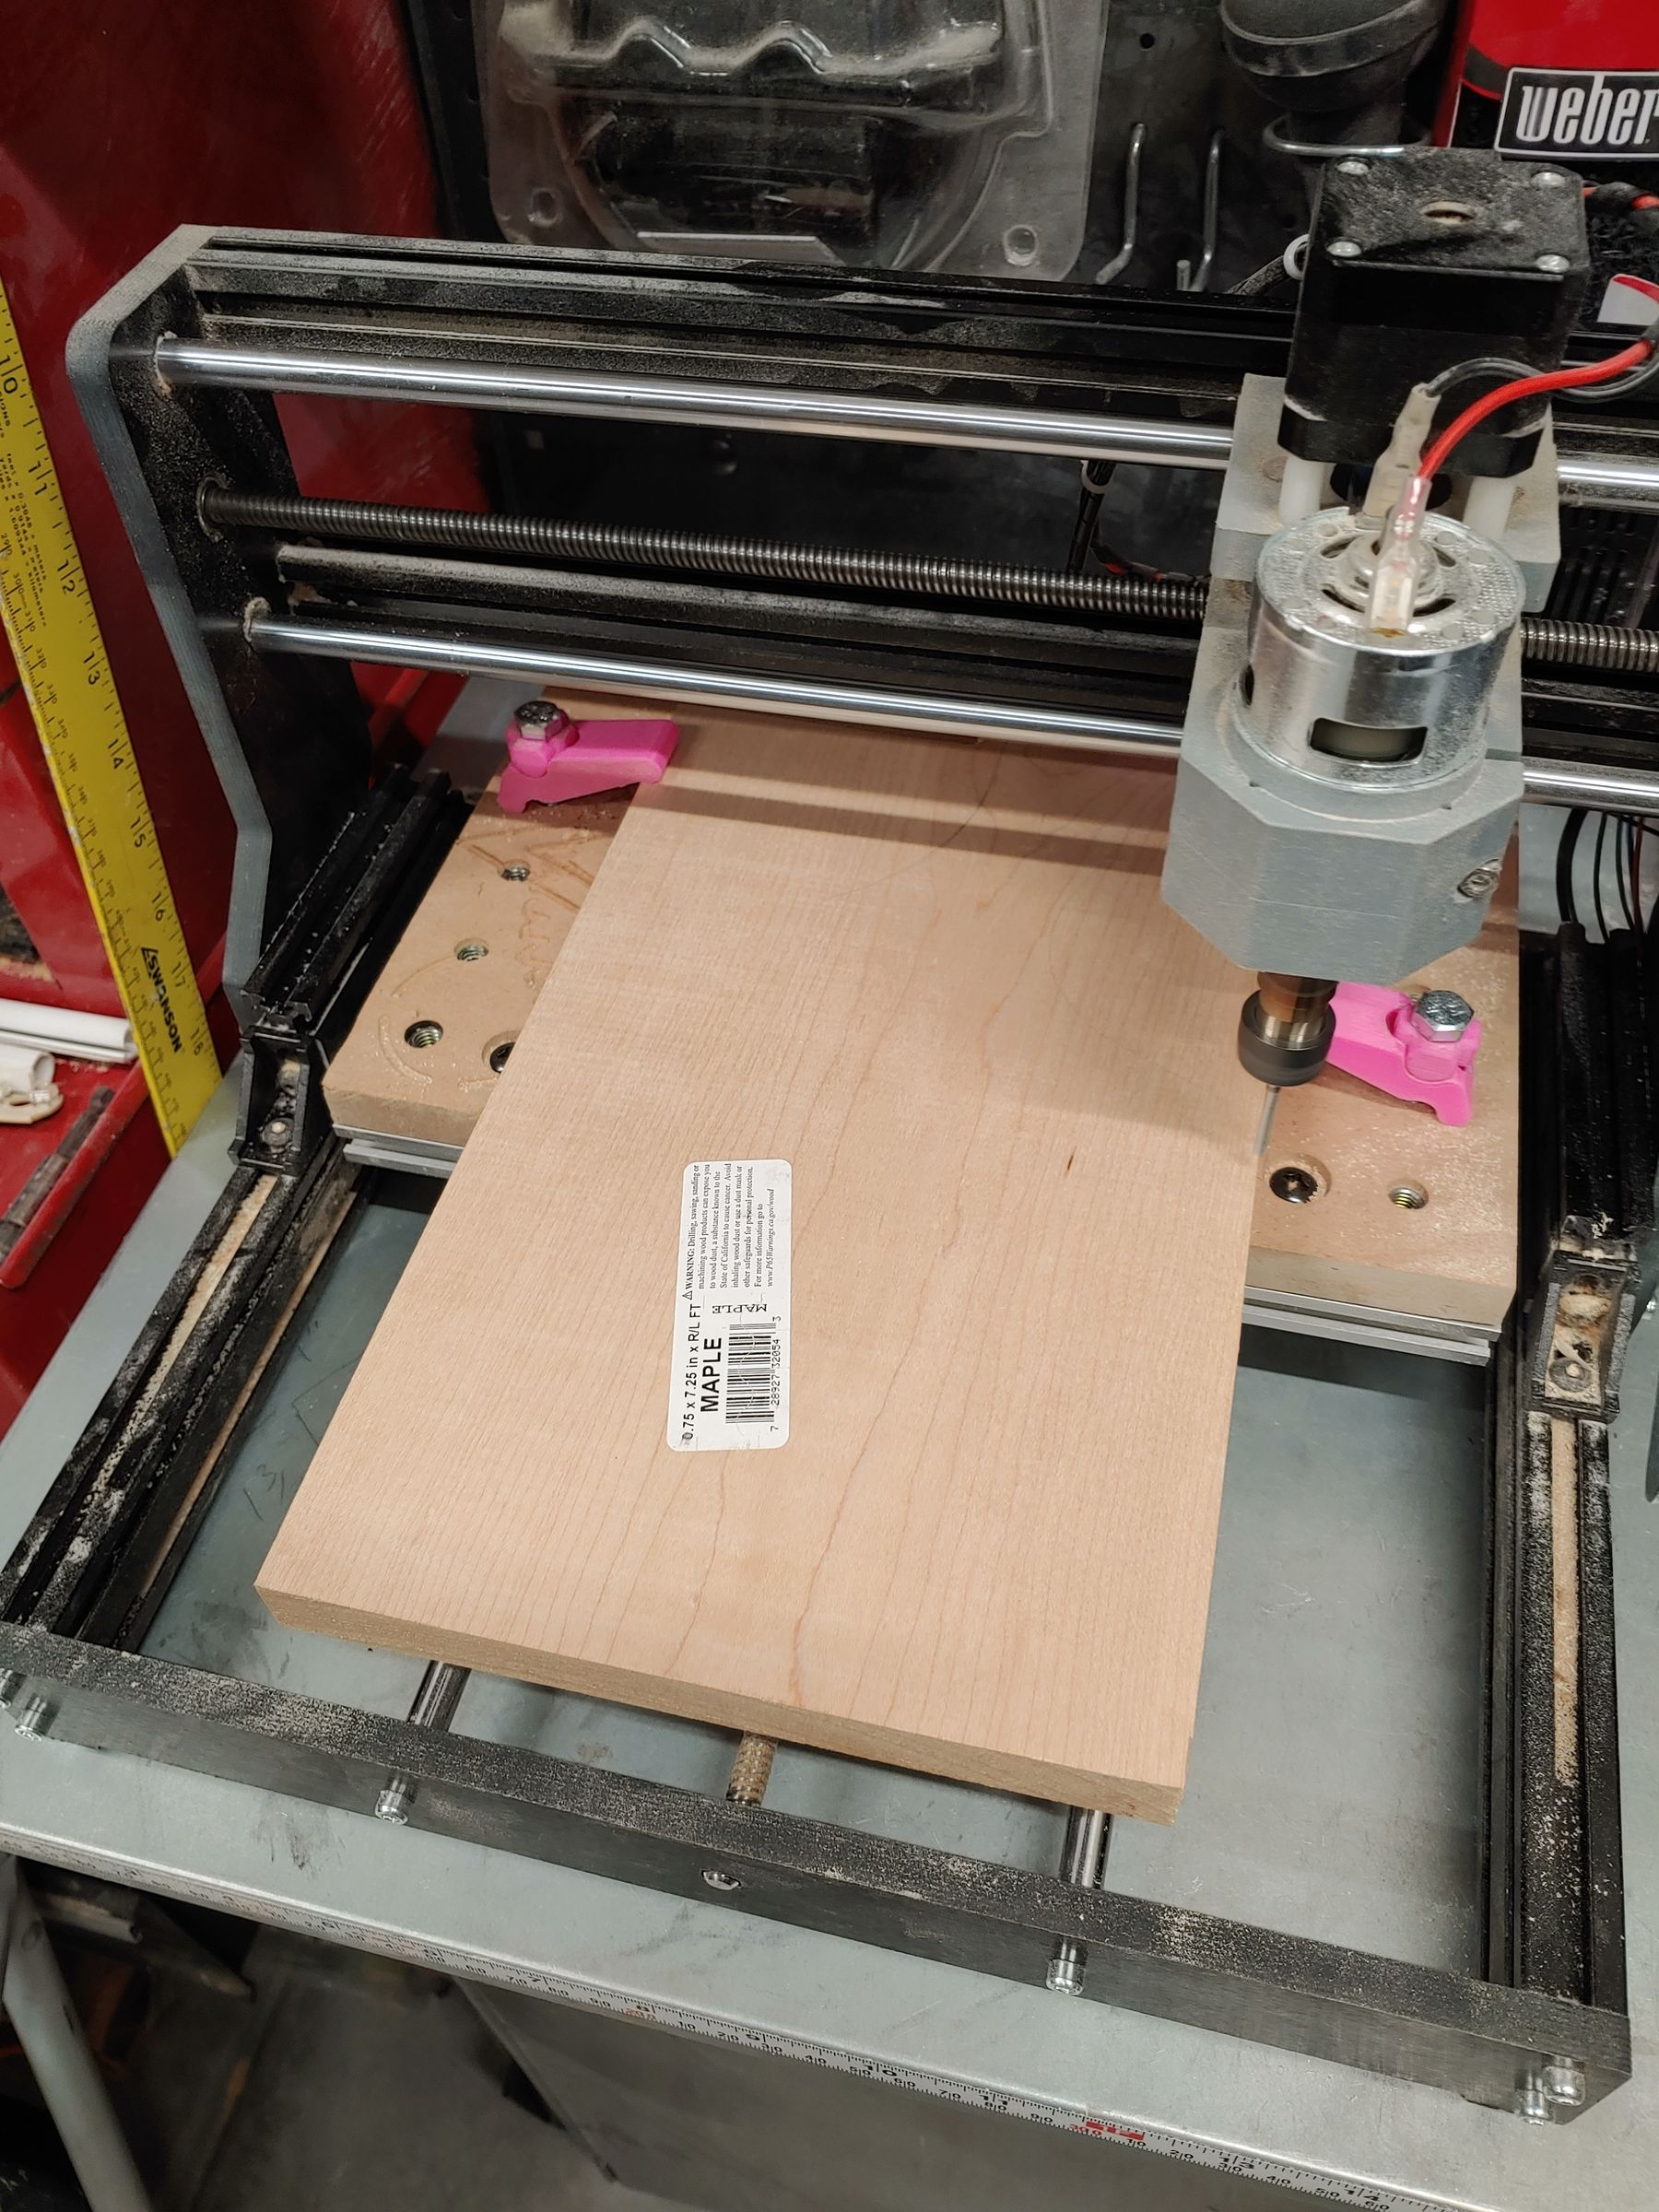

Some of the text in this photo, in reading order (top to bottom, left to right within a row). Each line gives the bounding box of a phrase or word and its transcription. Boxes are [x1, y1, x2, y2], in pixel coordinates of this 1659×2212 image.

[1516, 75, 1659, 146] weber
[57, 559, 76, 596] 12
[83, 651, 101, 686] 13
[108, 738, 124, 770] 14
[131, 818, 147, 848] 15
[147, 954, 182, 1053] SWANSON
[700, 1209, 709, 1236] products
[745, 1199, 754, 1224] personal
[758, 1211, 765, 1219] go
[685, 1248, 695, 1289] WARNING:
[691, 1172, 700, 1195] sanding
[766, 1188, 775, 1287] www.P65Warnings.ca.gov/wood
[721, 1263, 728, 1271] of
[744, 1237, 752, 1269] safeguards
[698, 1256, 707, 1289] machining
[732, 1262, 741, 1288] inhaling
[689, 1304, 700, 1318] FT
[712, 1303, 767, 1313] MAPLE
[688, 1322, 700, 1341] R/L
[687, 1358, 698, 1368] in
[772, 1339, 781, 1369] 32054
[685, 1372, 697, 1397] 7.25
[700, 1337, 722, 1412] MAPLE
[771, 1374, 780, 1406] 28927
[682, 1413, 694, 1440] 0.75
